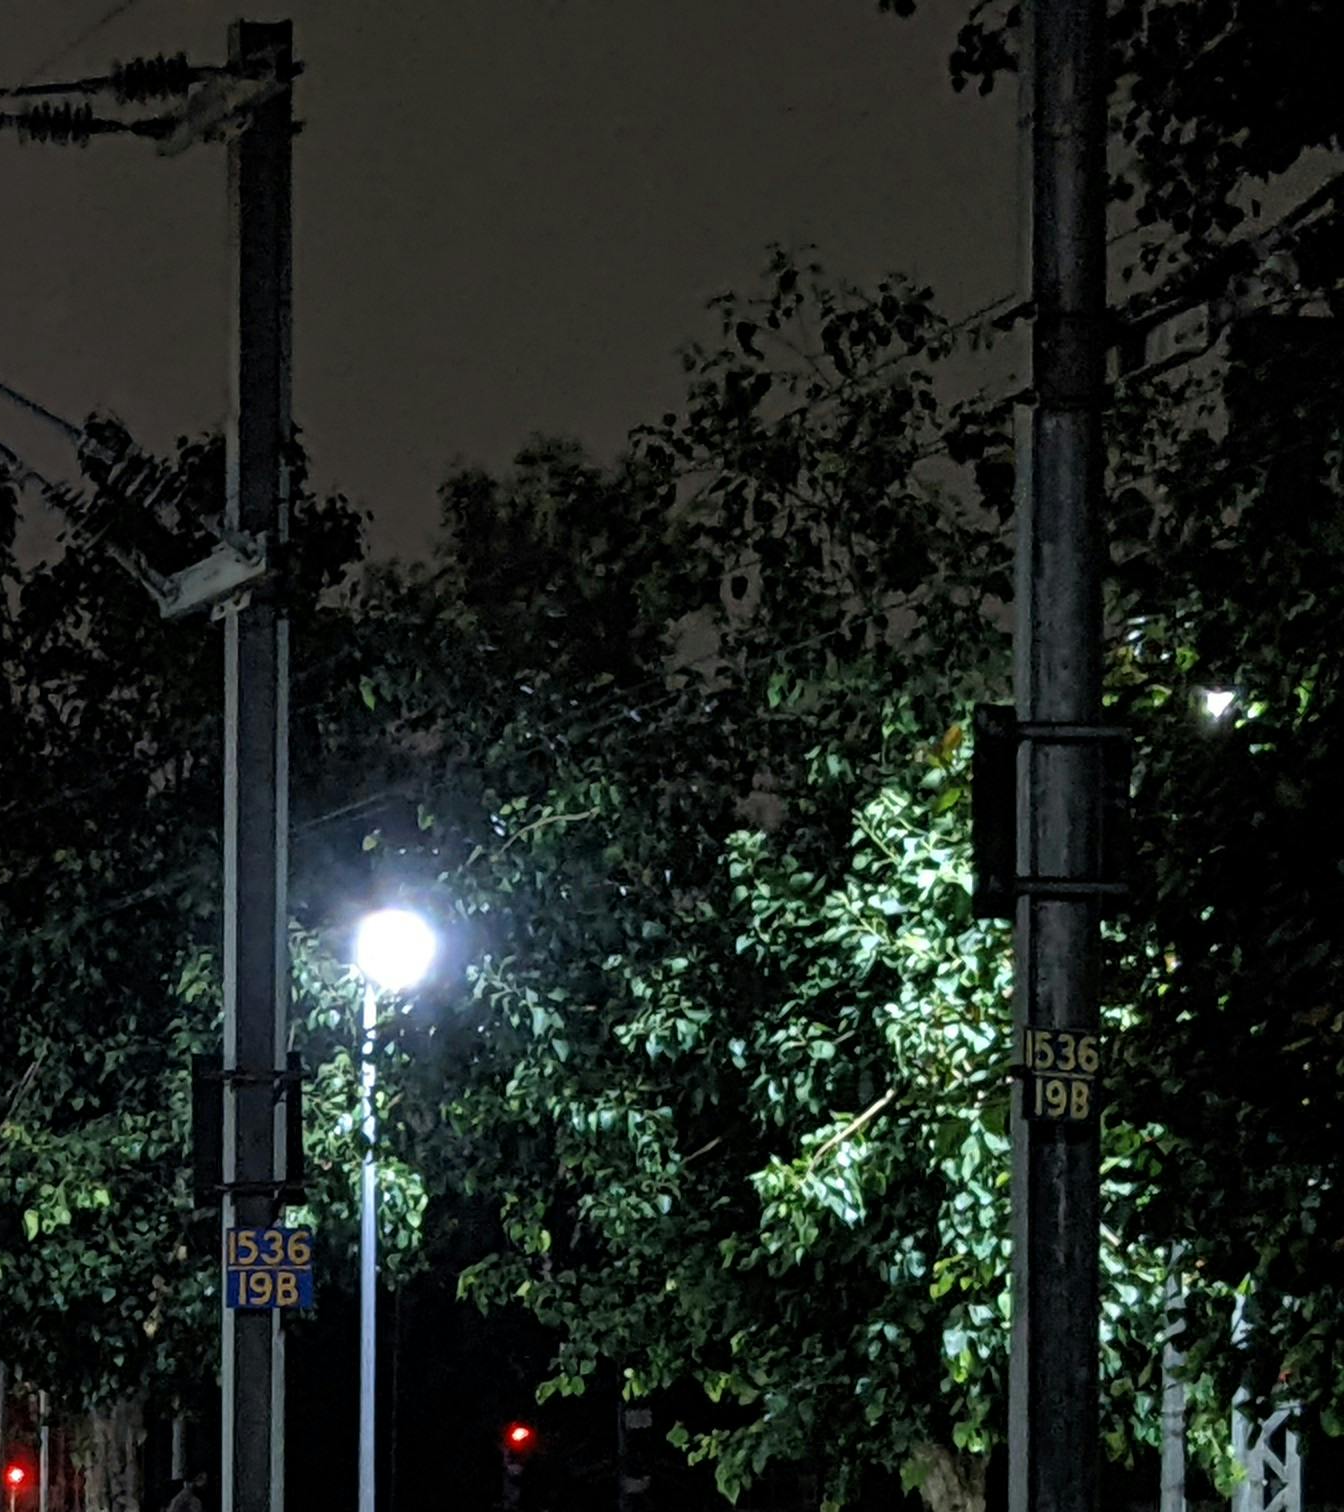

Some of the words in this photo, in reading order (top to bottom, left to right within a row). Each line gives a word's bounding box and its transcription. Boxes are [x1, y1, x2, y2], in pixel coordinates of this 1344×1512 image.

[1025, 1029, 1100, 1073] 1536
[1033, 1077, 1090, 1120] 19B
[228, 1230, 312, 1266] 1536
[238, 1271, 300, 1307] 19B
